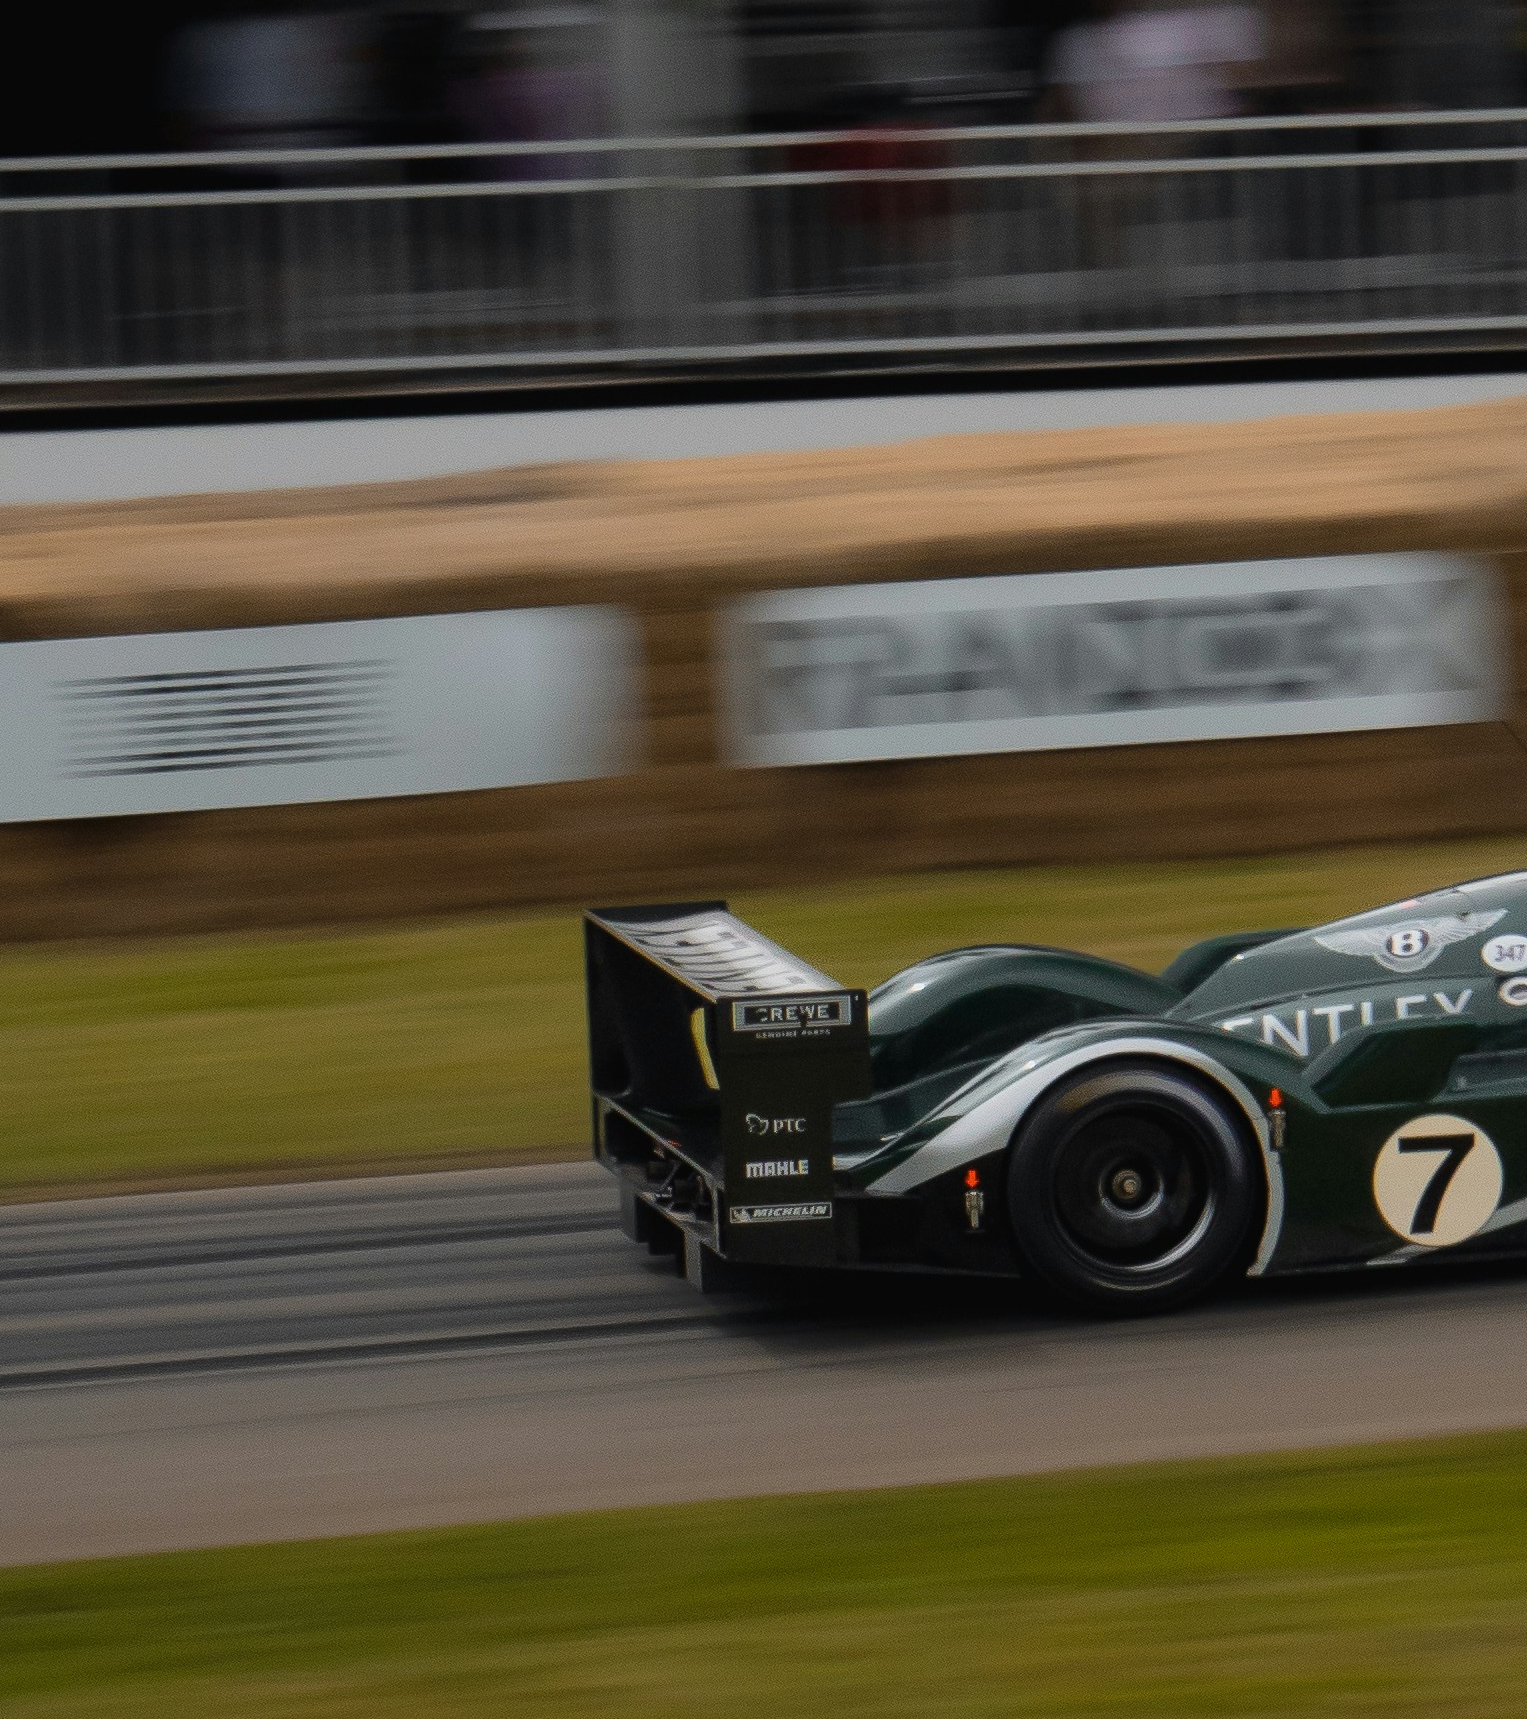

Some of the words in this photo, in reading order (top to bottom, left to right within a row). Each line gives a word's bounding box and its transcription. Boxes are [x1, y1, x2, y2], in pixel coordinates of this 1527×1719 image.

[1494, 944, 1527, 963] 347
[754, 1004, 830, 1023] CREWE
[773, 1117, 807, 1134] PTC
[745, 1159, 810, 1179] MAHLE
[1397, 1133, 1476, 1236] 7
[752, 1205, 828, 1218] MICHELIN
